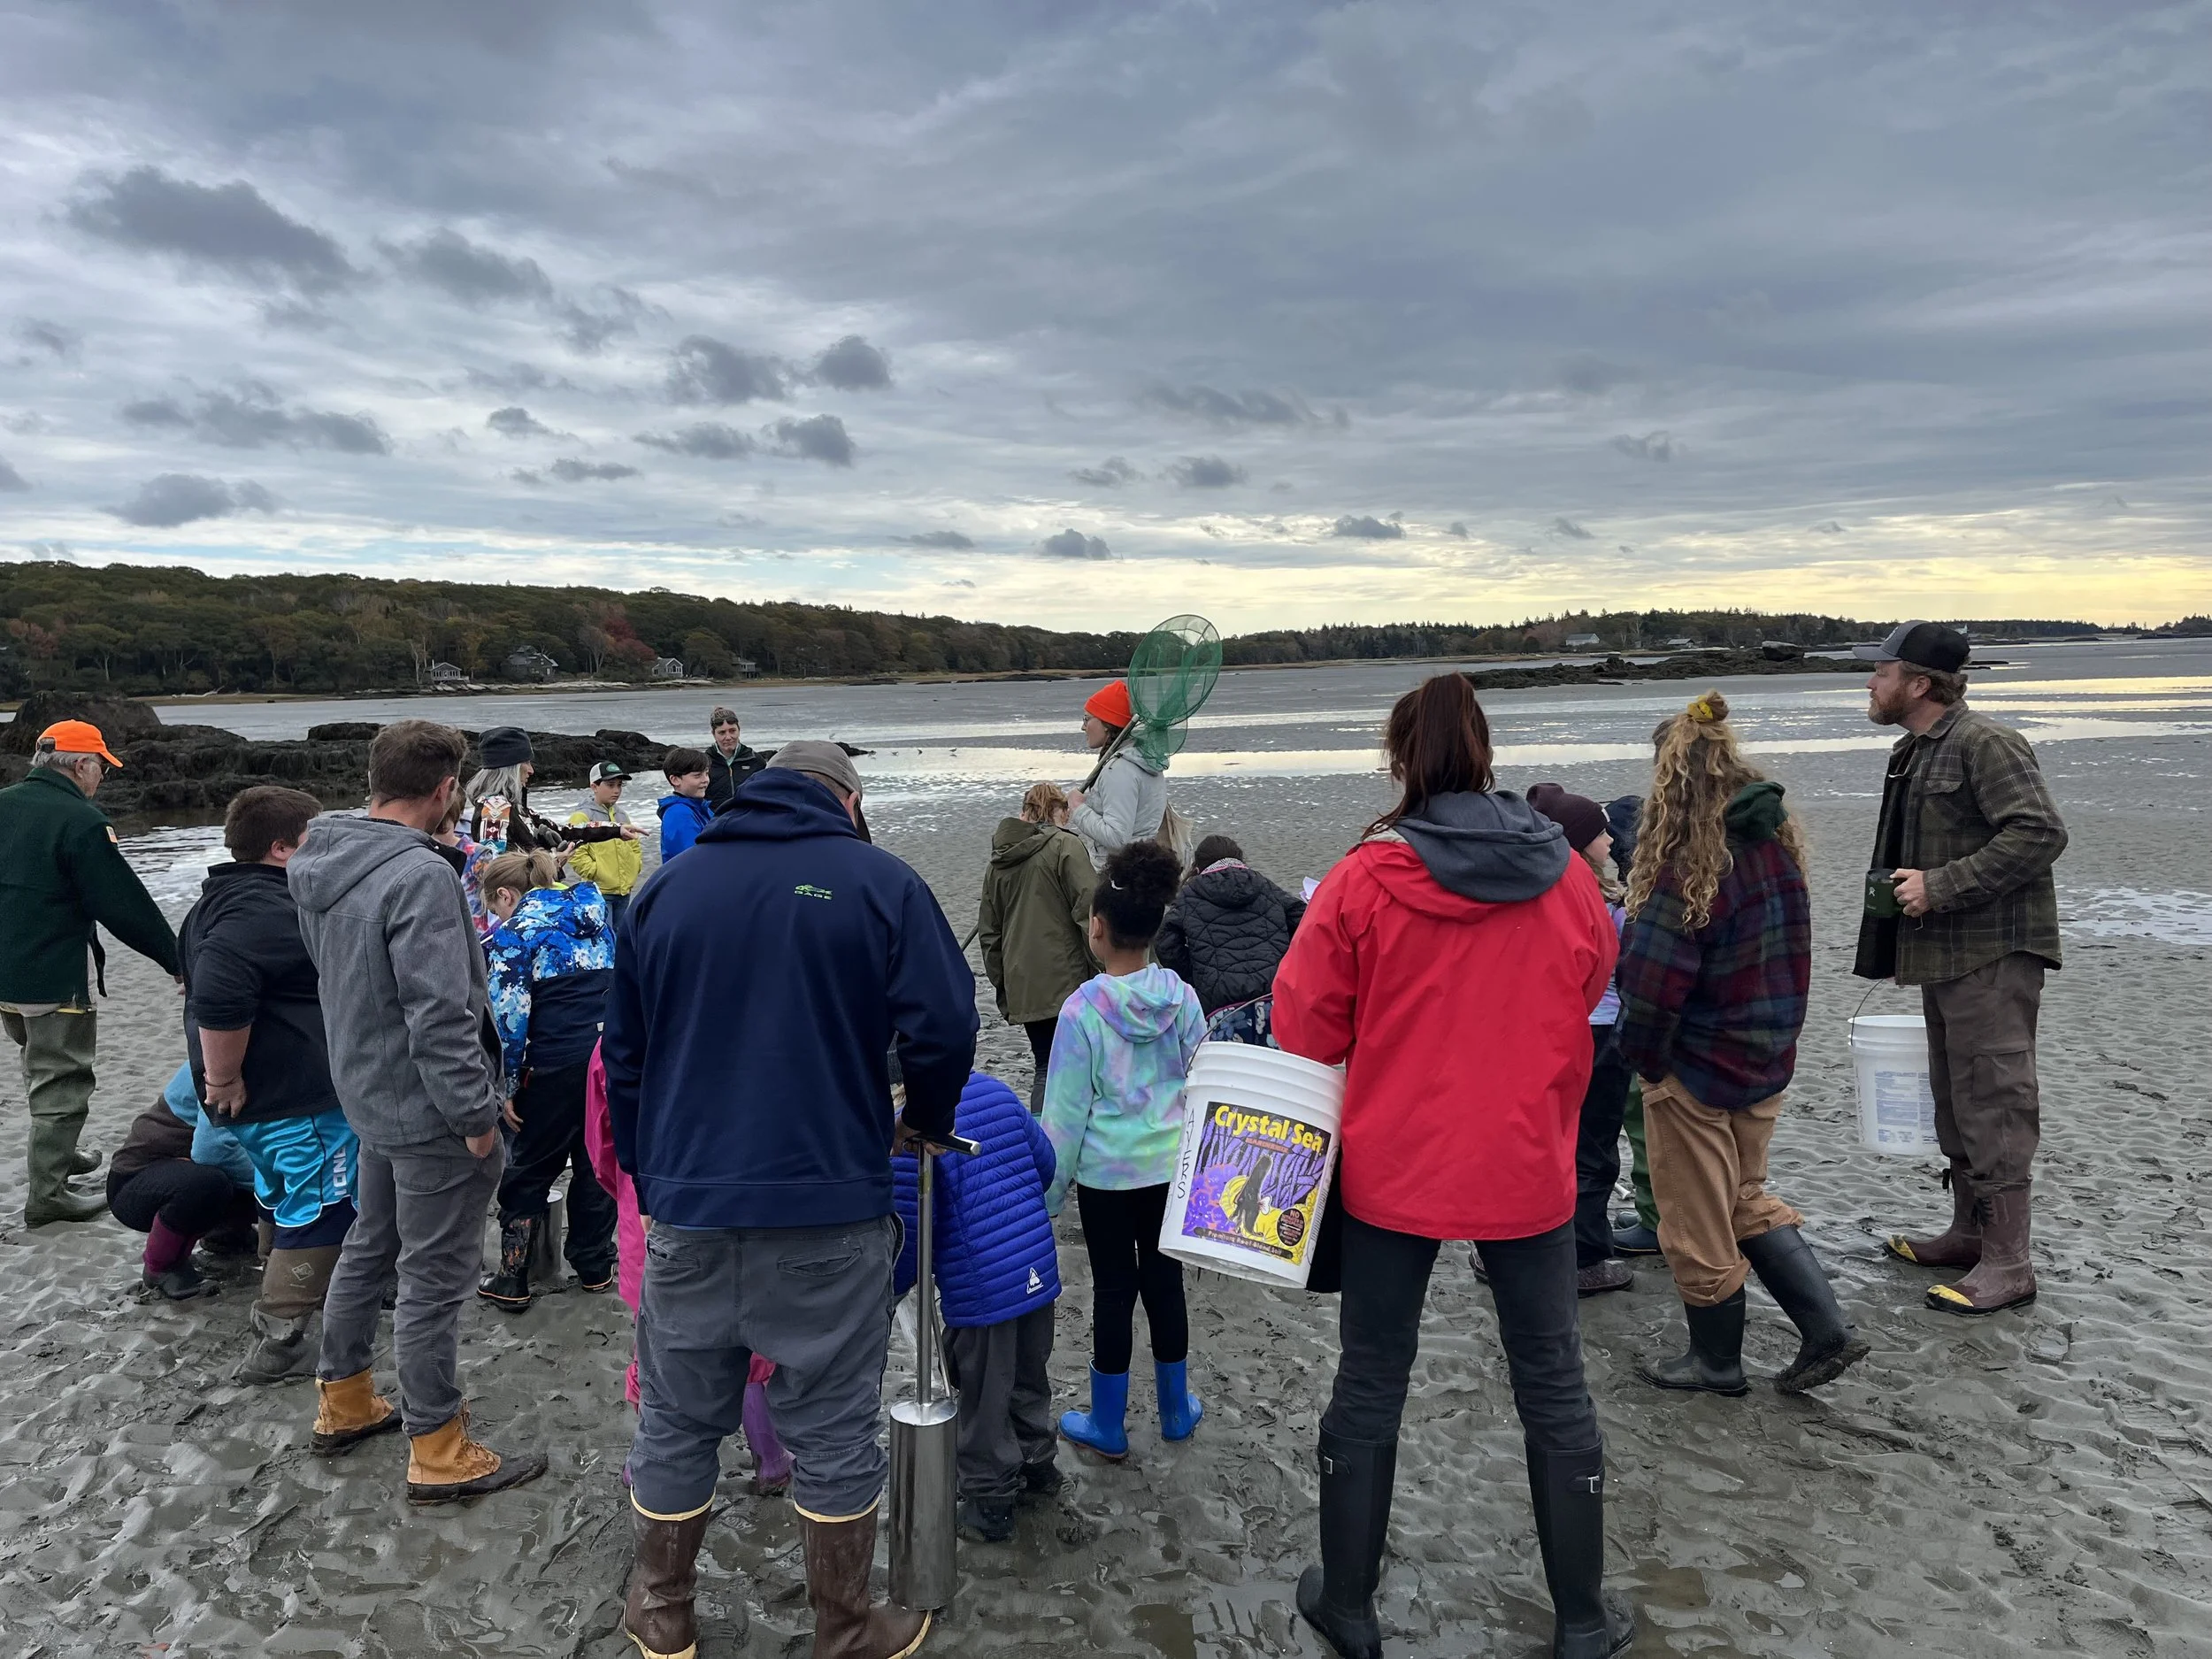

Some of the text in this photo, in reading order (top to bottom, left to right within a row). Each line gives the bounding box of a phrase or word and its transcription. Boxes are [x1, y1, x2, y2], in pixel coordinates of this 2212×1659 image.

[1177, 1109, 1195, 1200] AYERS
[1215, 1105, 1323, 1153] Crystal Sea
